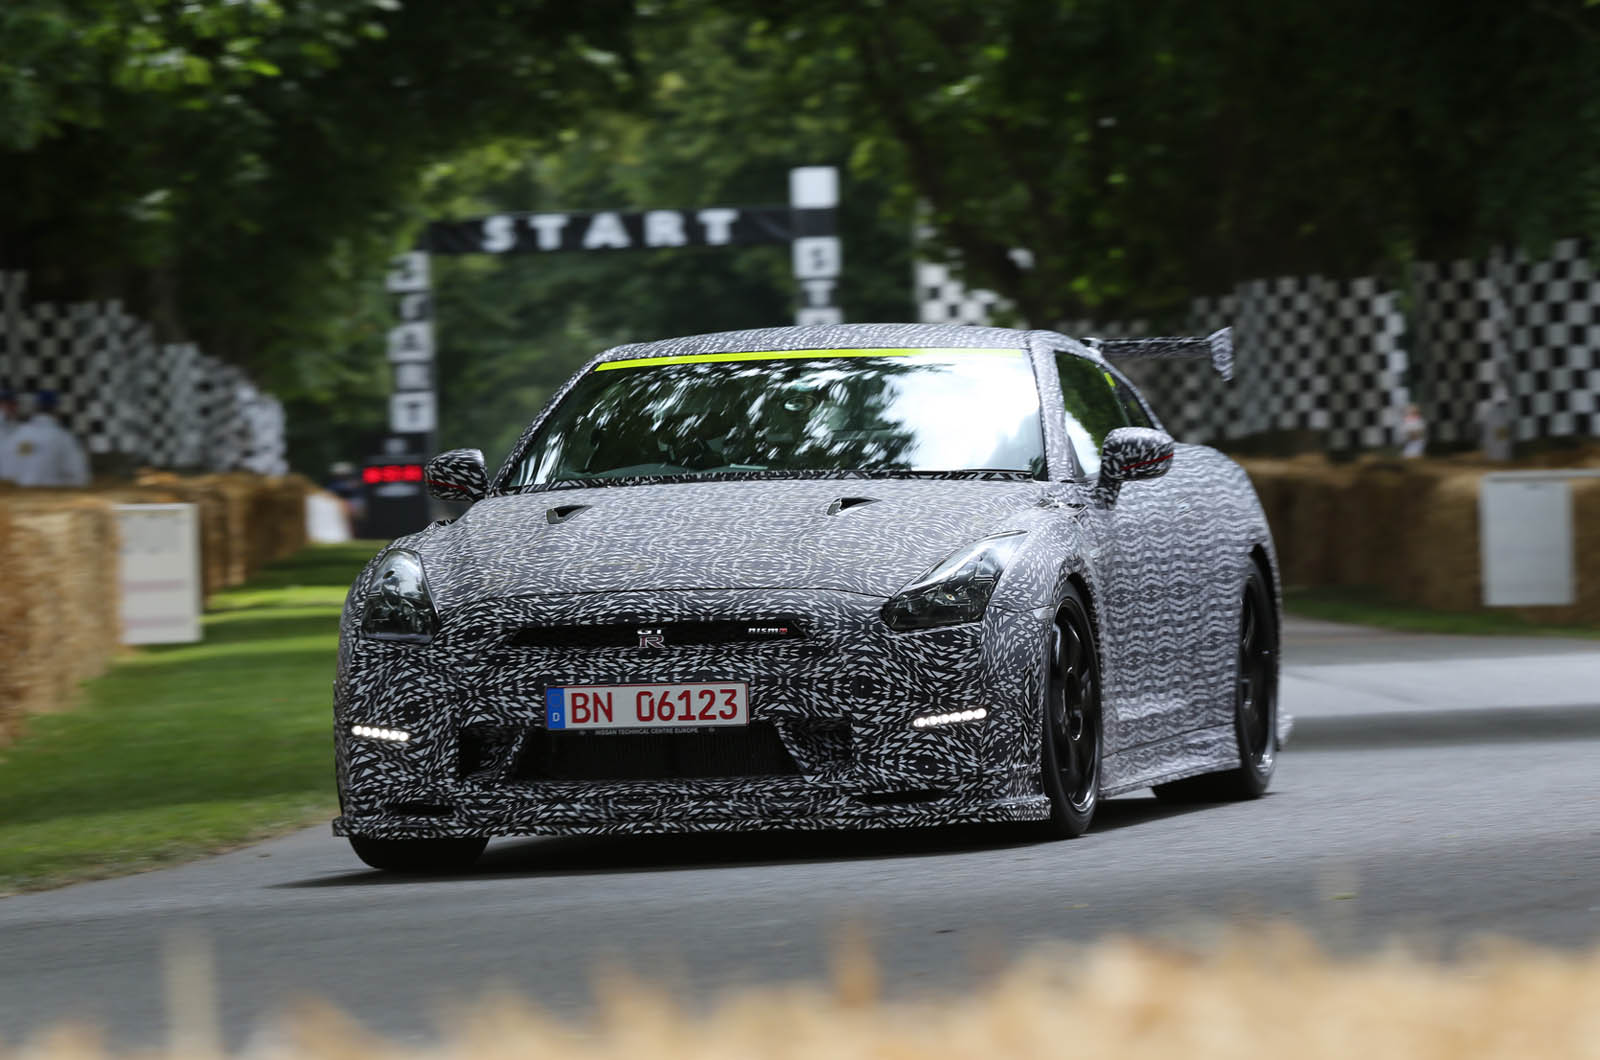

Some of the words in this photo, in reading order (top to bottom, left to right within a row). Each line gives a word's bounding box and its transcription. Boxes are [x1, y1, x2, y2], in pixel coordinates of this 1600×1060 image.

[481, 208, 739, 253] START
[552, 712, 560, 722] D
[571, 692, 613, 723] BN
[636, 689, 738, 722] 06123
